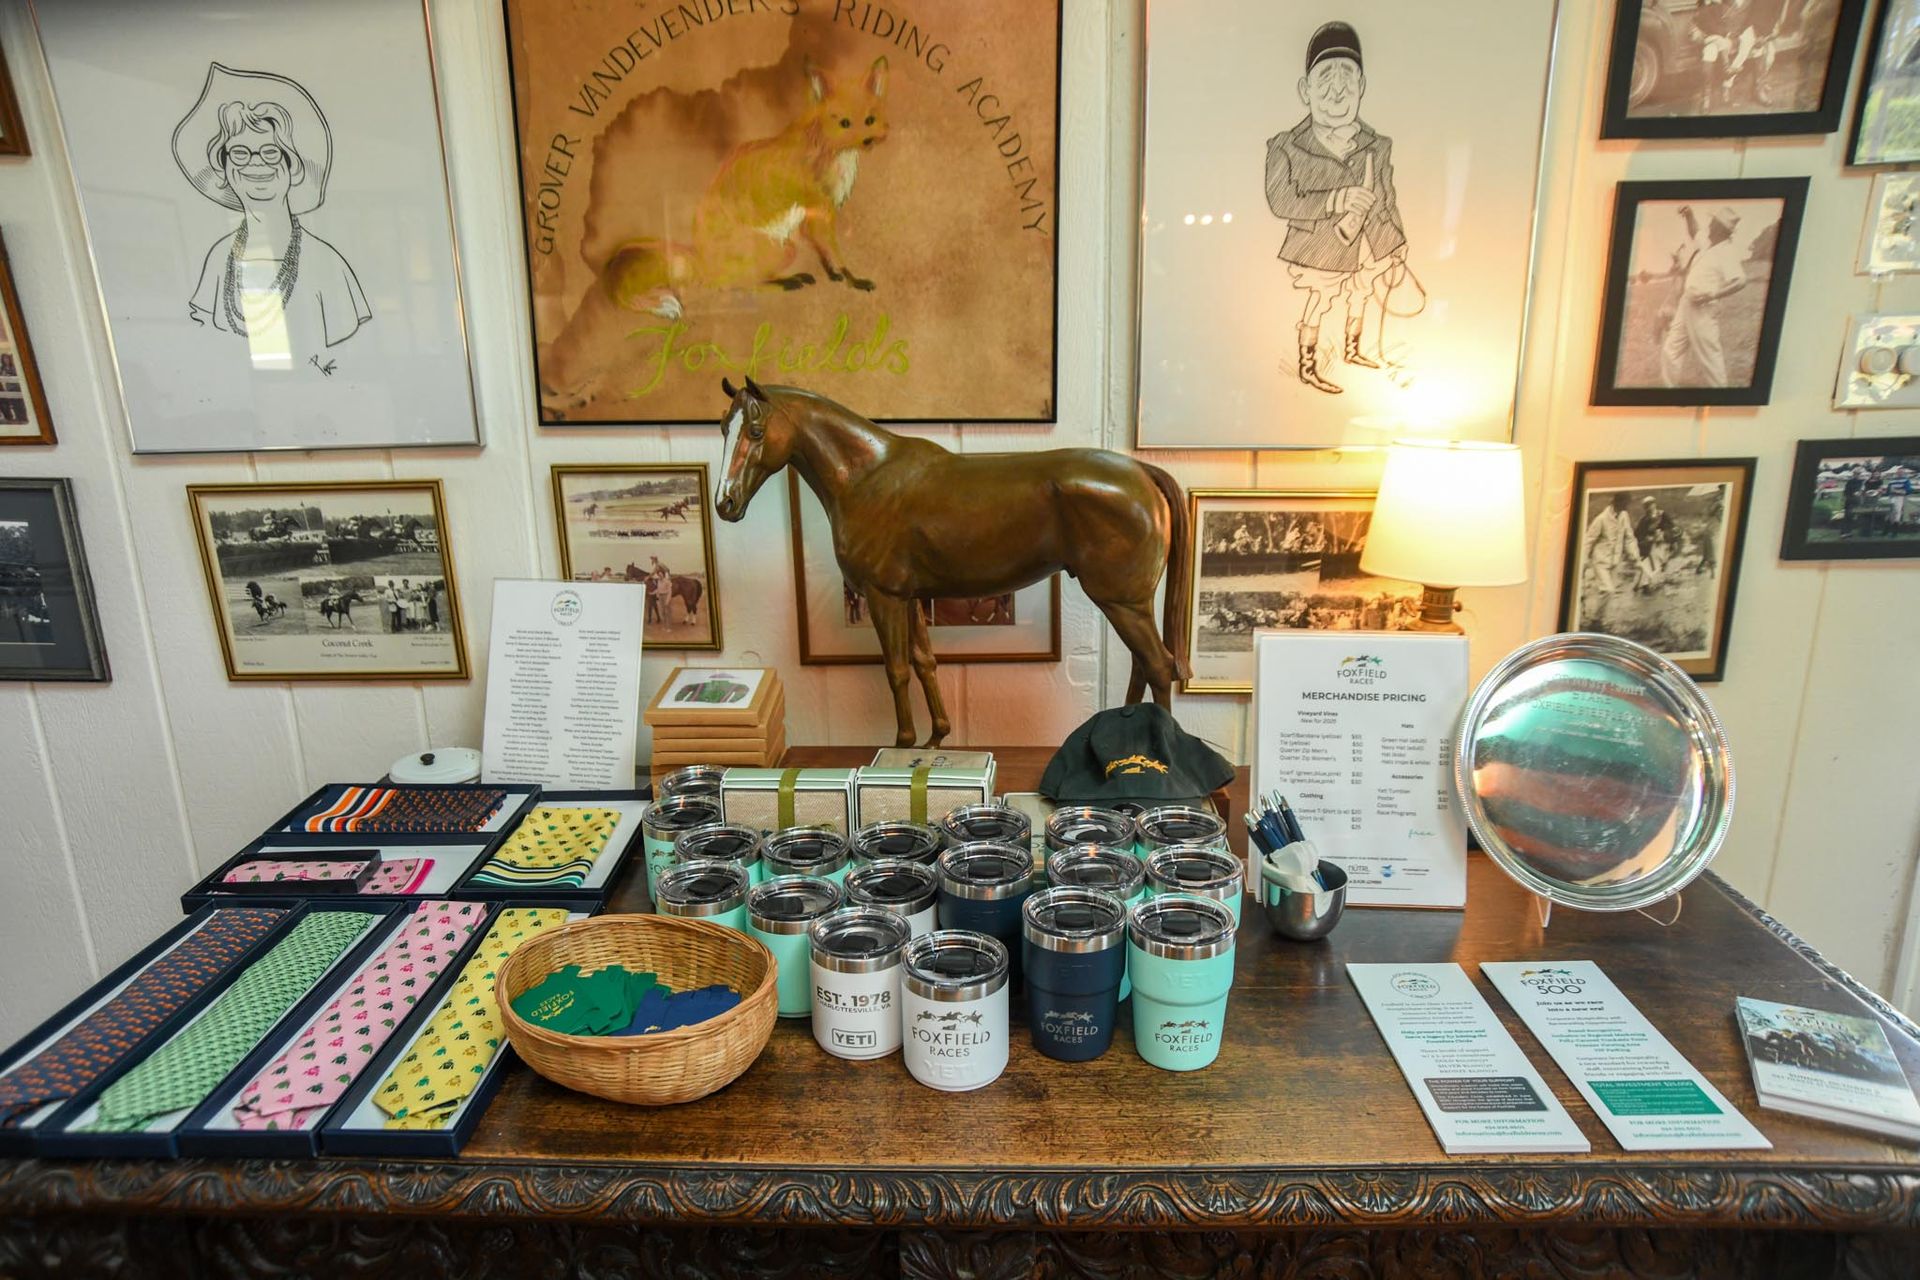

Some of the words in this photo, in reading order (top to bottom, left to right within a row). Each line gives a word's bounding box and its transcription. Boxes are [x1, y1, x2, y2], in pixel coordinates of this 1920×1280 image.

[534, 132, 582, 257] GROVER
[832, 0, 951, 75] RIDING
[956, 75, 1049, 238] ACADEMY
[322, 638, 351, 648] Coconut
[352, 638, 375, 648] Creek
[1337, 667, 1388, 680] FOXFIELD
[1349, 678, 1375, 686] RACES
[1301, 691, 1380, 702] MERCHANDISE
[1382, 692, 1427, 703] PRICING
[1520, 977, 1586, 987] FOXFIELD
[1536, 984, 1583, 995] 500
[816, 985, 847, 1006] EST.
[851, 990, 891, 1007] 1978
[531, 990, 574, 1017] FOXFIELD
[1041, 1022, 1099, 1037] FOXFIELD
[835, 1032, 872, 1046] YETI
[911, 1026, 991, 1046] FOXFIELD
[1053, 1034, 1084, 1045] RACES
[1154, 1032, 1213, 1045] FOXFIELD
[929, 1046, 970, 1058] RACES
[1169, 1044, 1200, 1053] RACES
